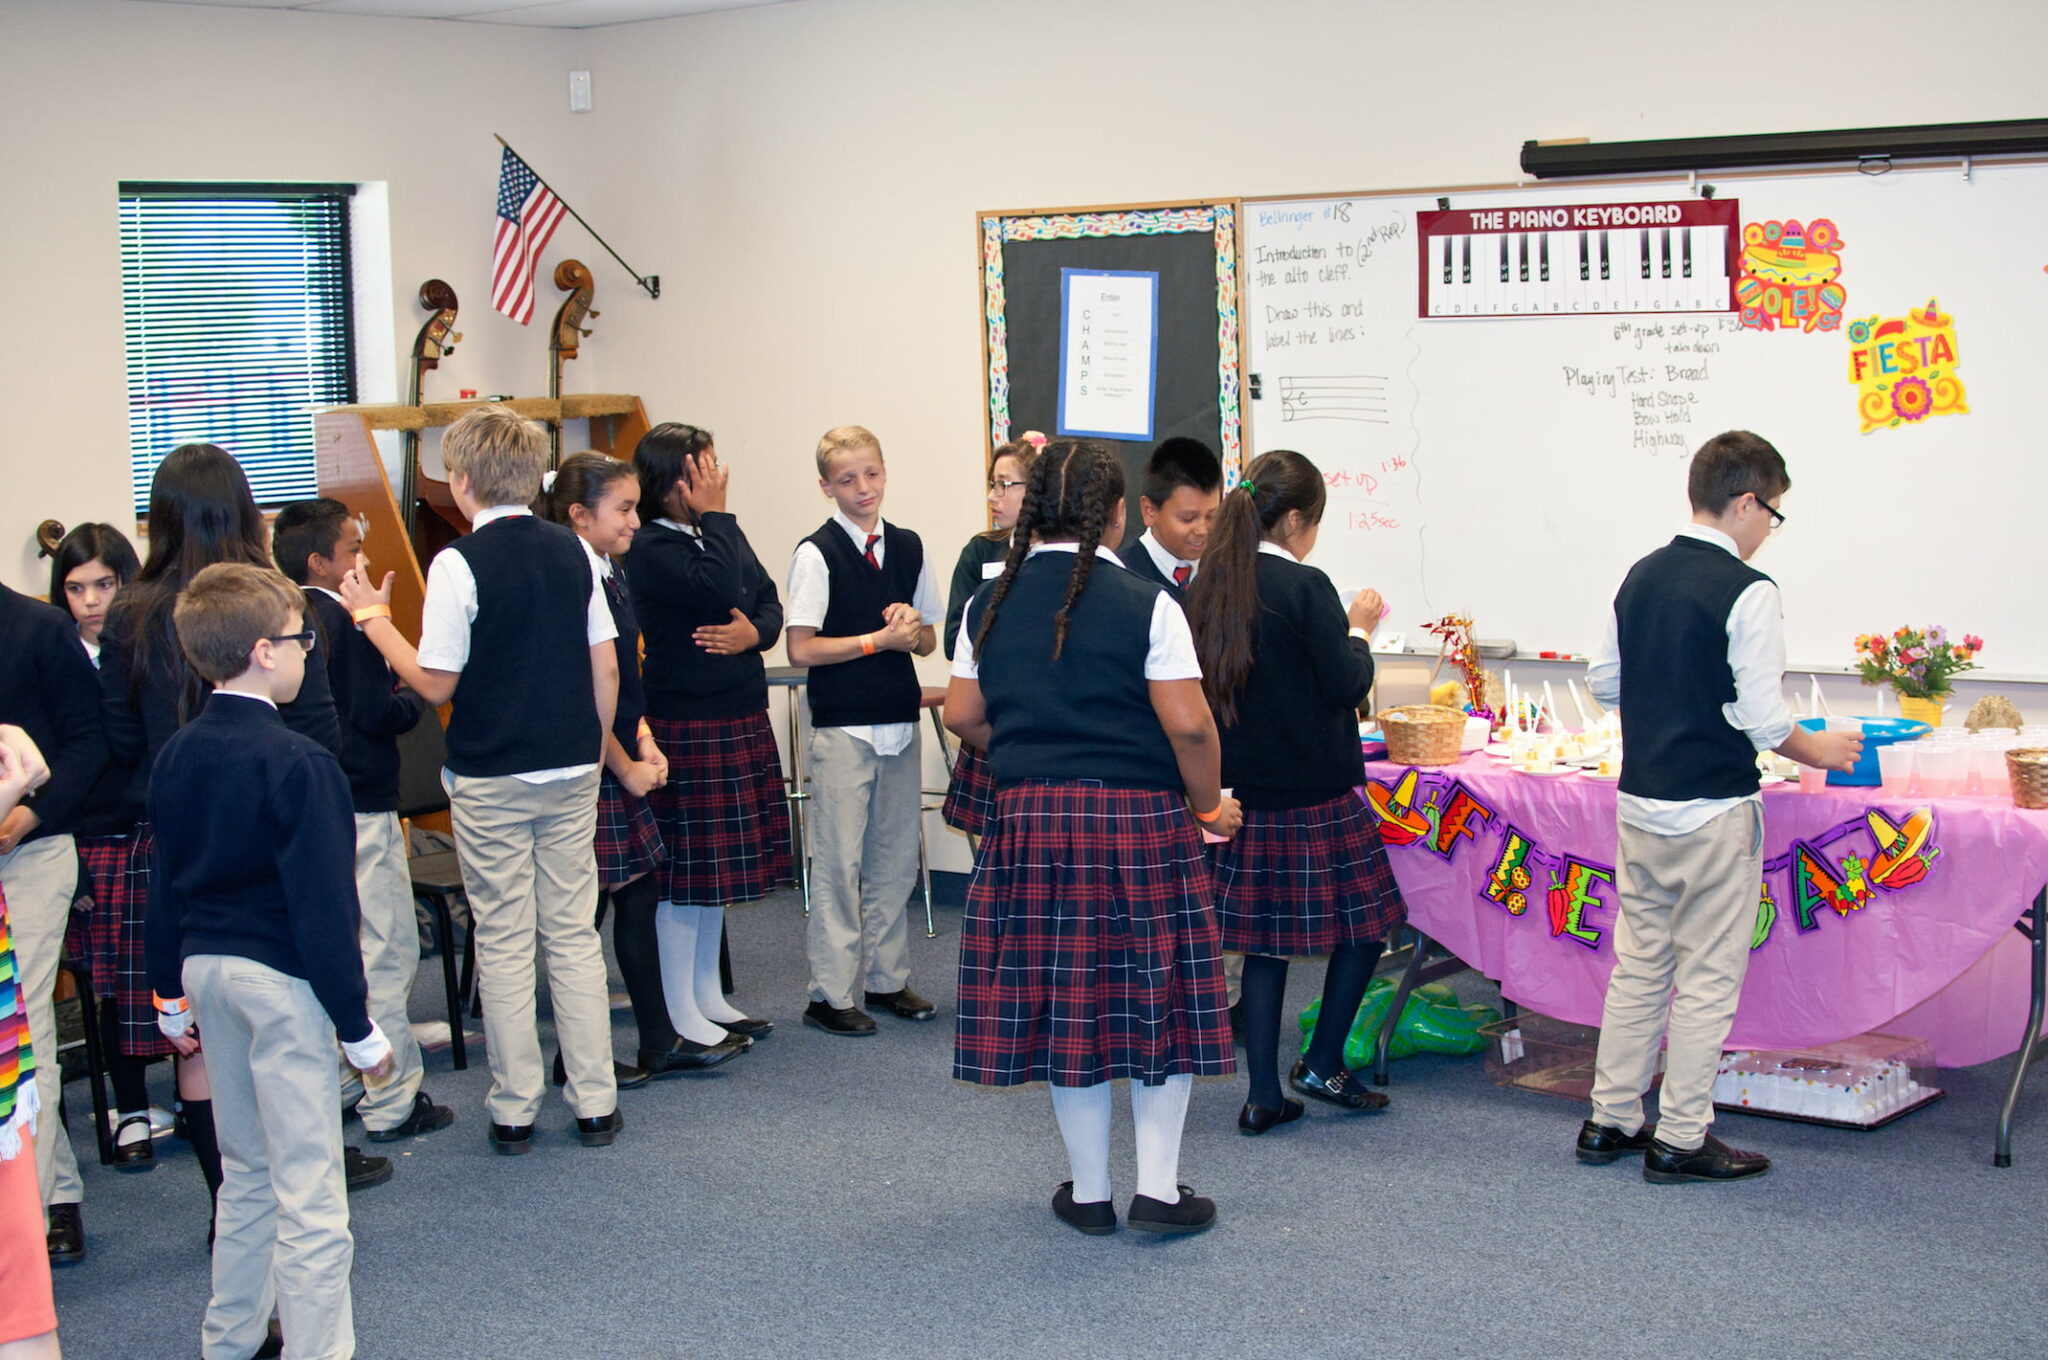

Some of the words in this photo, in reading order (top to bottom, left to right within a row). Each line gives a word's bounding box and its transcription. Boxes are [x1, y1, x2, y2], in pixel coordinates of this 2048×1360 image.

[1470, 212, 1504, 231] THE
[1508, 209, 1569, 229] PIANO
[1573, 204, 1682, 227] KEYBOARD
[1255, 243, 1327, 265] Introduction
[1336, 241, 1353, 258] to
[1256, 268, 1277, 288] the
[1285, 266, 1309, 285] alto
[1100, 293, 1121, 303] Enter
[1303, 301, 1333, 319] this
[1341, 299, 1363, 317] and
[1763, 286, 1816, 328] OLE!
[1265, 330, 1291, 351] label
[1296, 326, 1318, 345] the
[1634, 321, 1665, 350] grade
[1851, 333, 1955, 381] FIESTA
[1562, 365, 1617, 398] Playing
[1664, 358, 1710, 382] Bread
[1657, 390, 1700, 408] Shape
[1633, 410, 1660, 427] Bow
[1665, 407, 1692, 424] Hold
[1633, 429, 1690, 458] Highway
